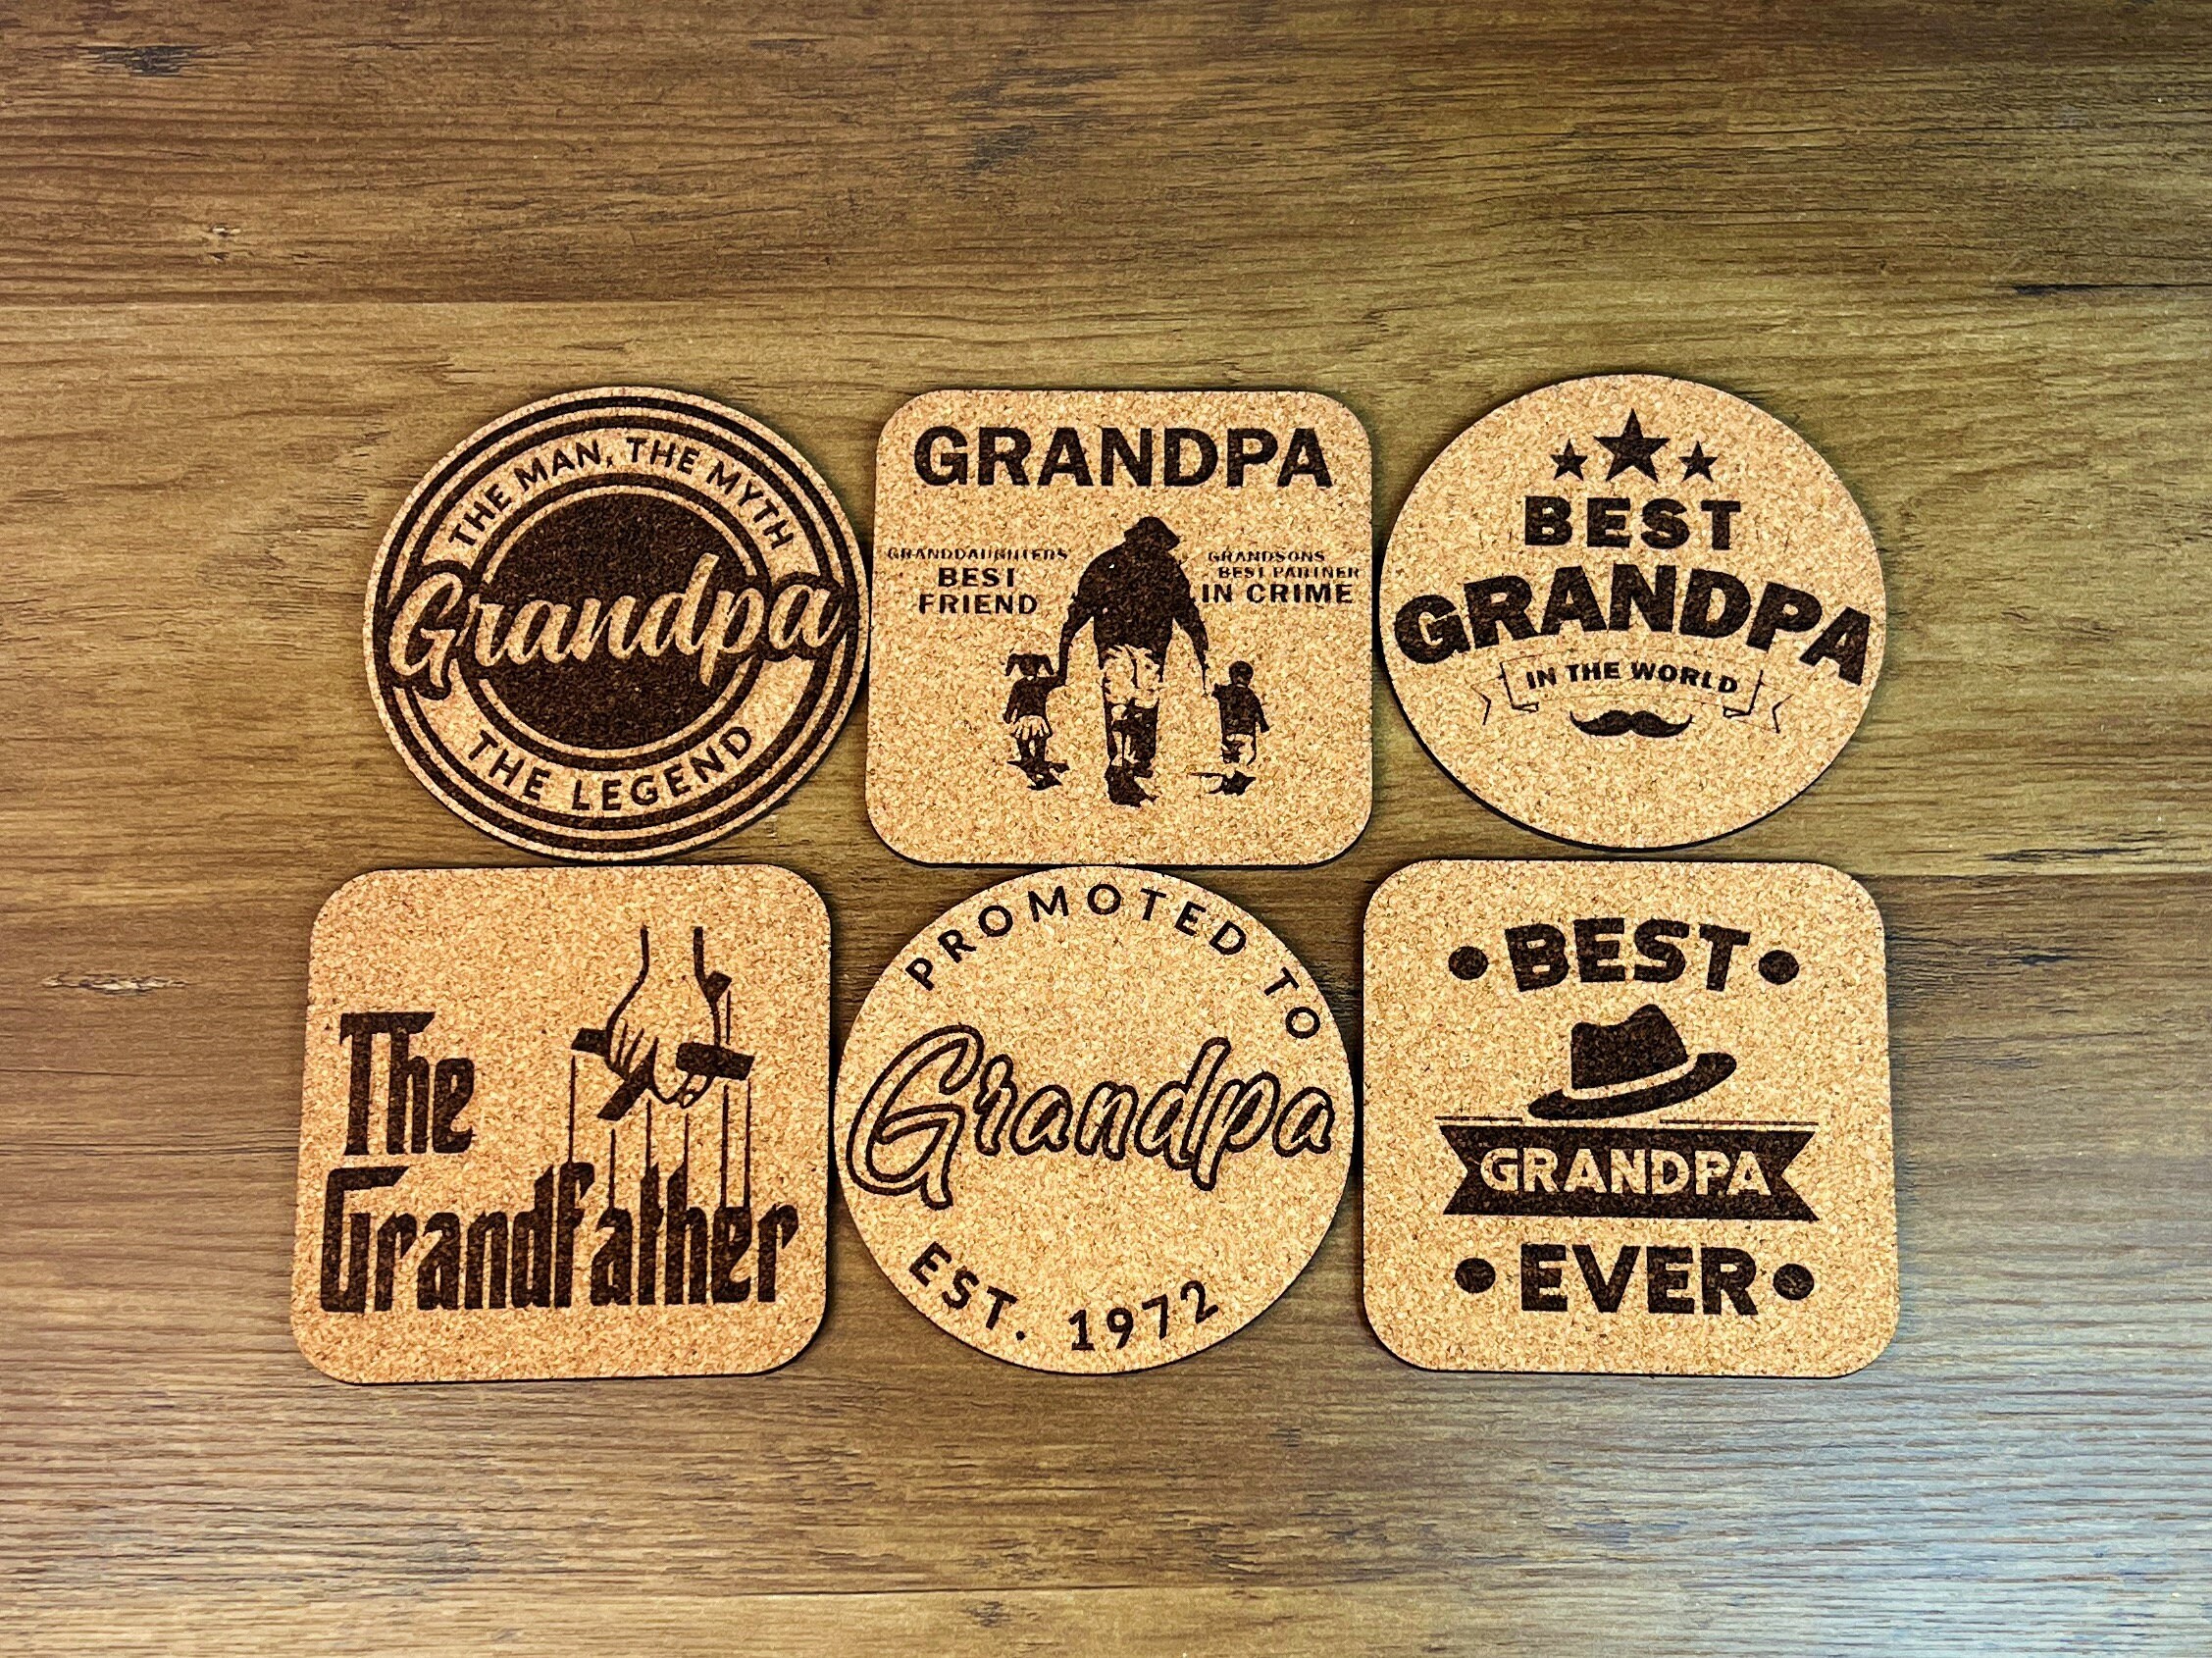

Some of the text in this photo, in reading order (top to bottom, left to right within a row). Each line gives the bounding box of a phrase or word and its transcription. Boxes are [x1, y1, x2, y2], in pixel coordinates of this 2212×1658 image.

[448, 438, 795, 549] THE MAN, THE MYTH
[913, 426, 1333, 488] GRANDPA
[1208, 550, 1325, 562] GRANDSONS
[1524, 495, 1741, 550] BEST
[918, 594, 1038, 615] FRIEND
[938, 567, 1015, 588] BEST
[1202, 583, 1353, 603] IN CRIME
[1218, 566, 1360, 579] BEST PARTNER
[388, 553, 843, 687] Grandpa
[1394, 564, 1872, 687] GRANDPA
[1525, 661, 1738, 693] IN THE WORLD
[468, 725, 752, 811] THE LEGEND
[904, 883, 1321, 1040] PROMOTED TO
[1504, 917, 1751, 993] BEST
[338, 1010, 477, 1156] The
[846, 1024, 1336, 1211] Grandpa
[1479, 1147, 1772, 1196] GRANDPA
[319, 1162, 799, 1313] Grandfather
[908, 1242, 1218, 1352] EST. 1972
[1520, 1243, 1760, 1316] EVER
